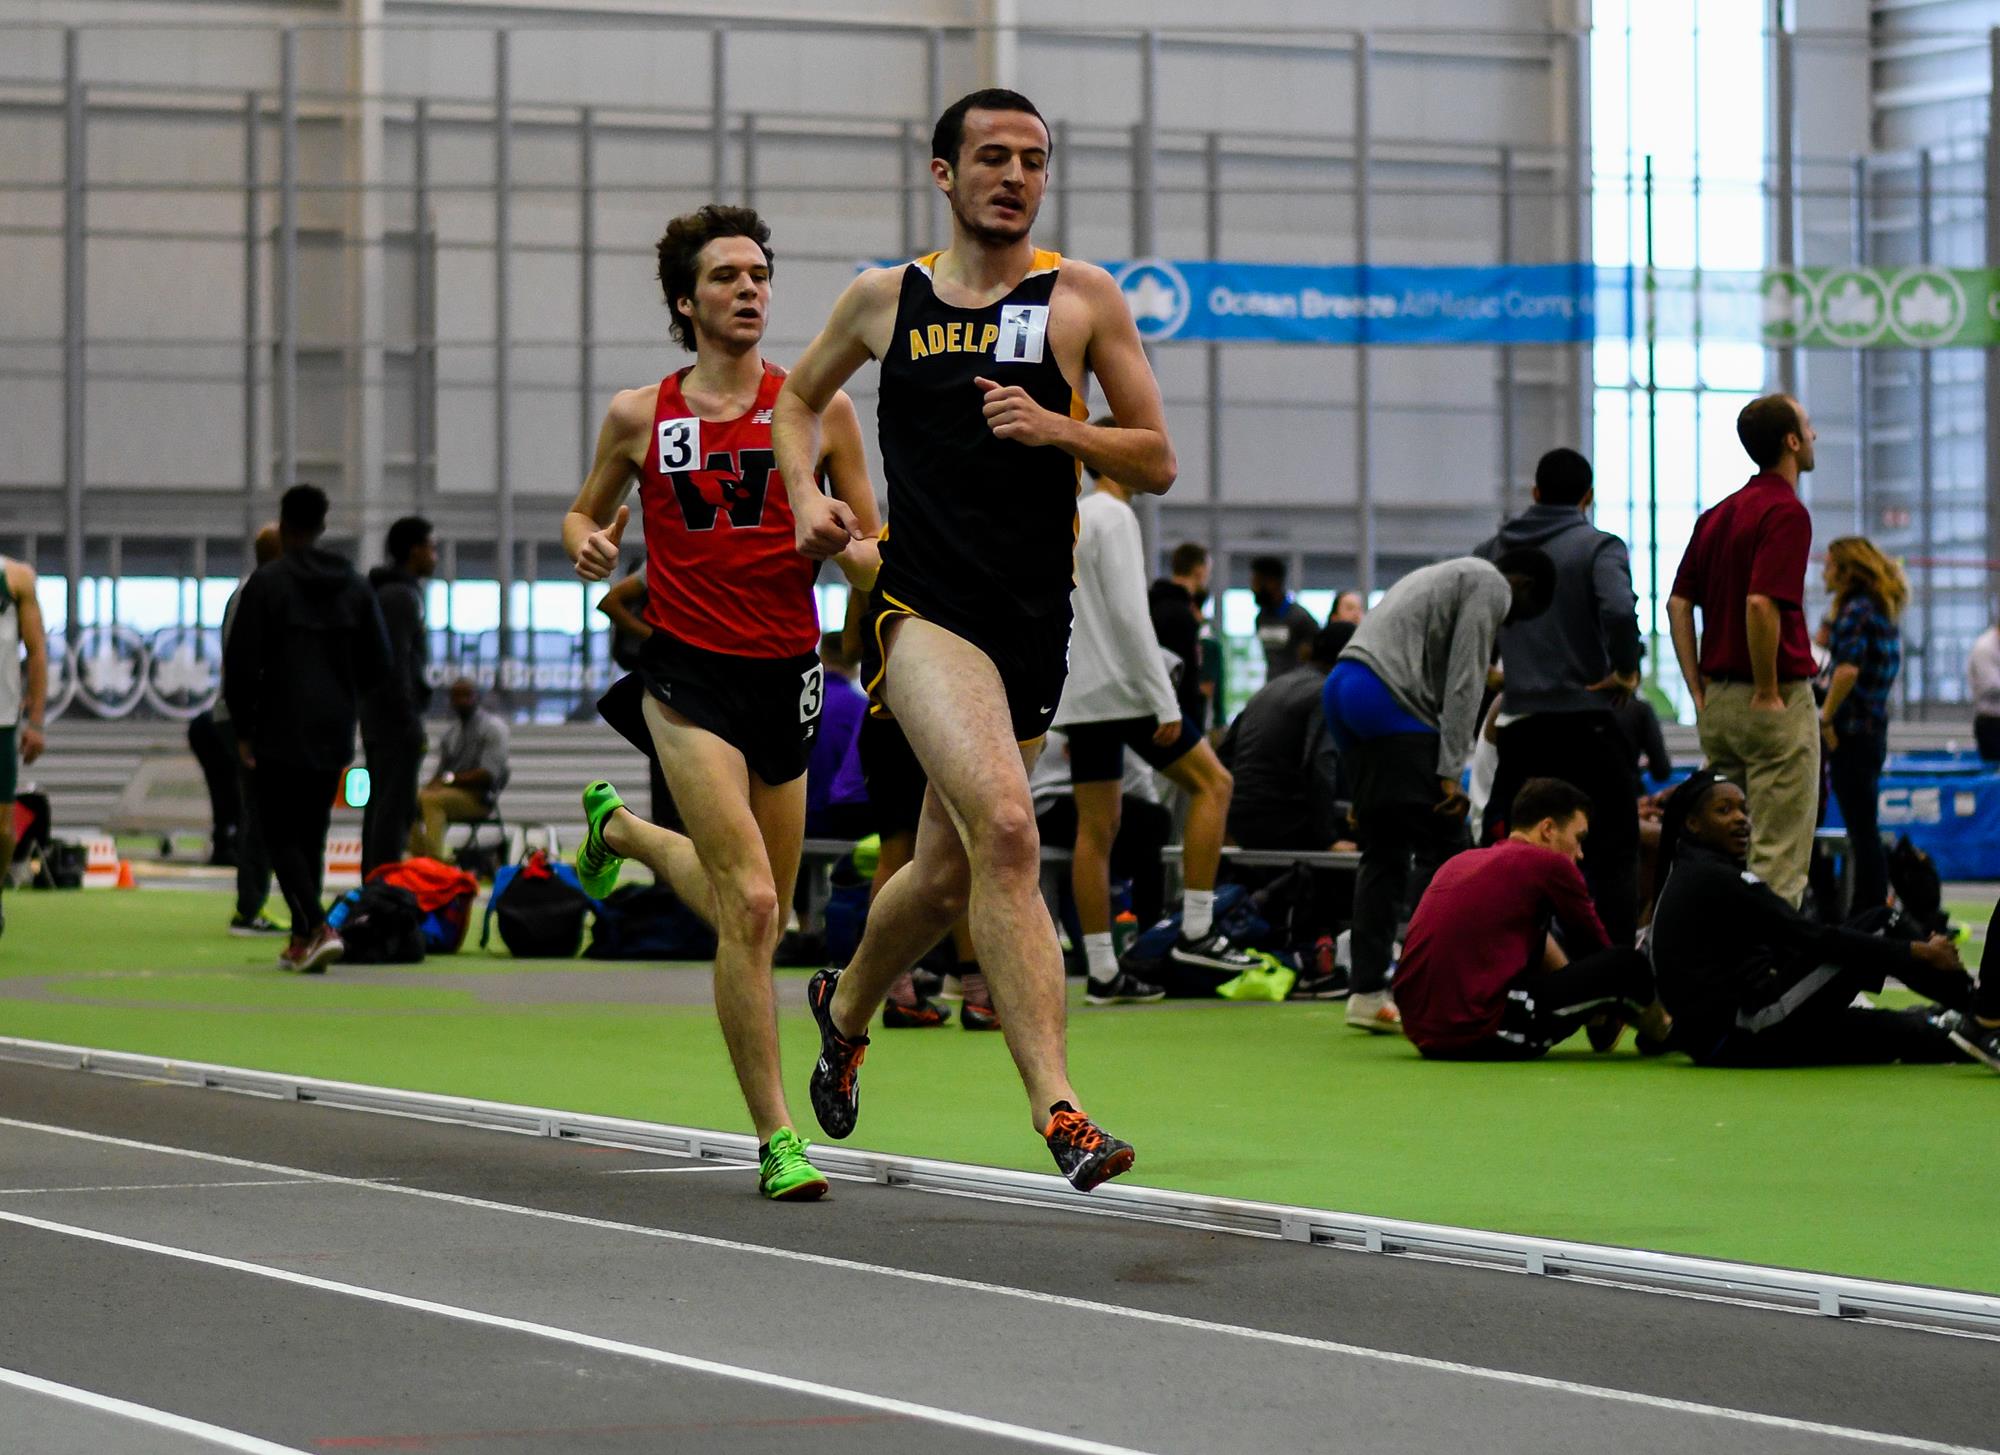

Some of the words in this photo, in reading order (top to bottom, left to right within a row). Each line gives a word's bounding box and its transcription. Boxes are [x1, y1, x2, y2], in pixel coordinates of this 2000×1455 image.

[1208, 286, 1298, 319] Ocean
[909, 322, 999, 361] ADELP
[1007, 309, 1032, 358] 1
[663, 422, 692, 468] 3
[802, 670, 821, 717] 3
